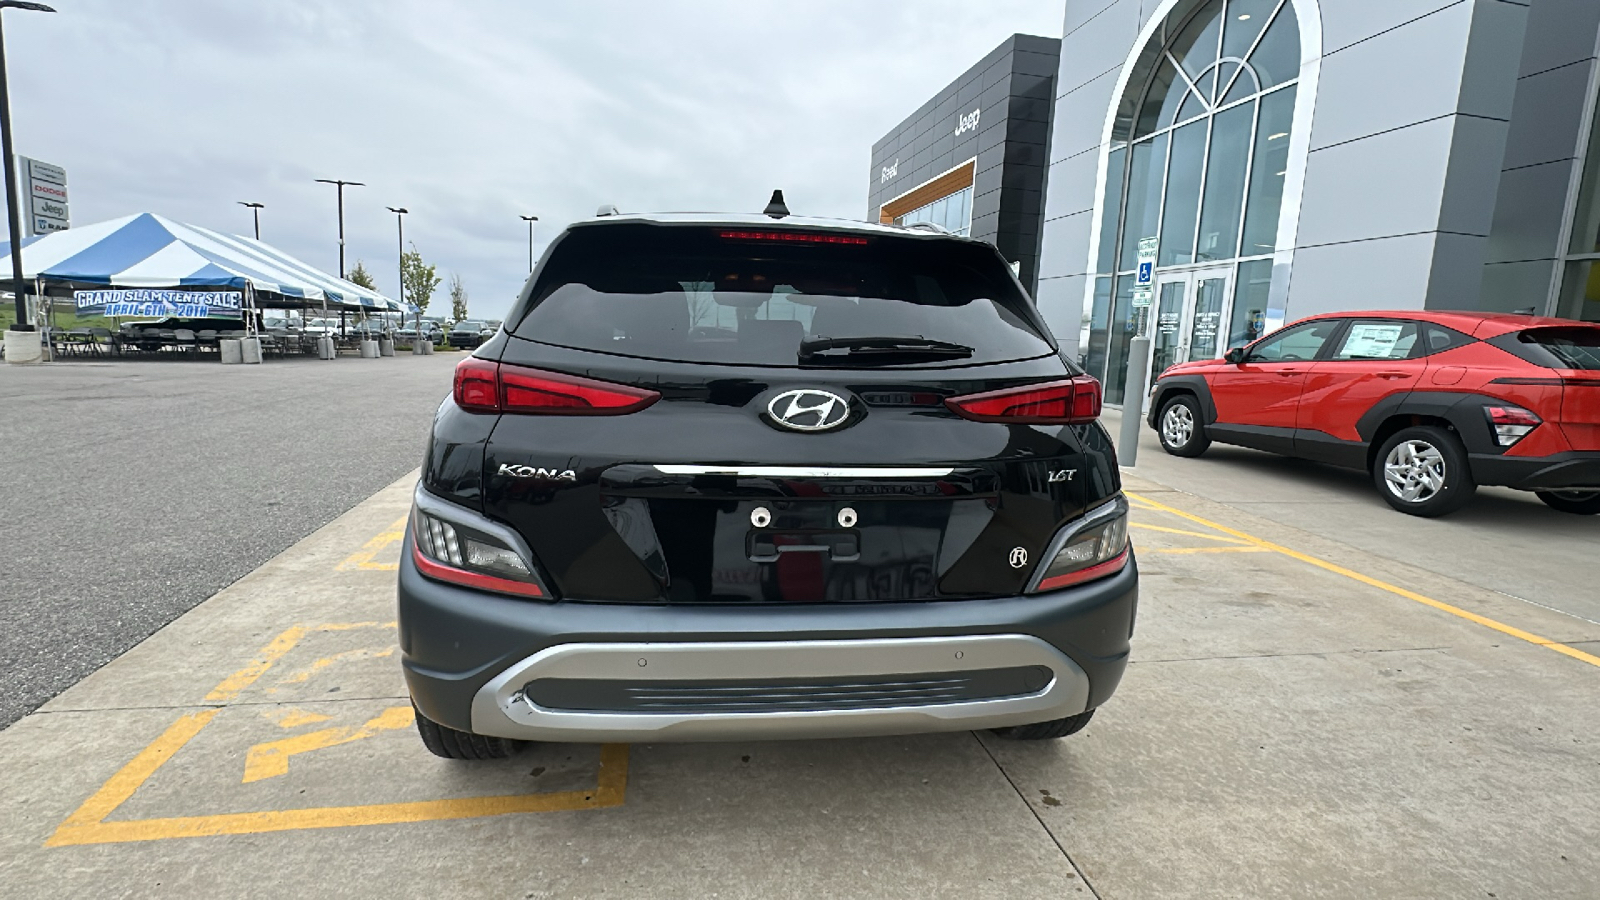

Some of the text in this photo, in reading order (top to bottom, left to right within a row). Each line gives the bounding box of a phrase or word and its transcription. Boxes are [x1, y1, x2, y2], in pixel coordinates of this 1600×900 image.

[955, 109, 980, 136] Jeep
[35, 185, 66, 197] DODGE
[42, 202, 64, 216] Jeep
[77, 291, 241, 309] GRAND SLAM TENT SALE
[104, 304, 140, 317] APRIL
[143, 304, 168, 316] 6TH
[176, 305, 209, 317] 20TH
[497, 463, 577, 481] KONA
